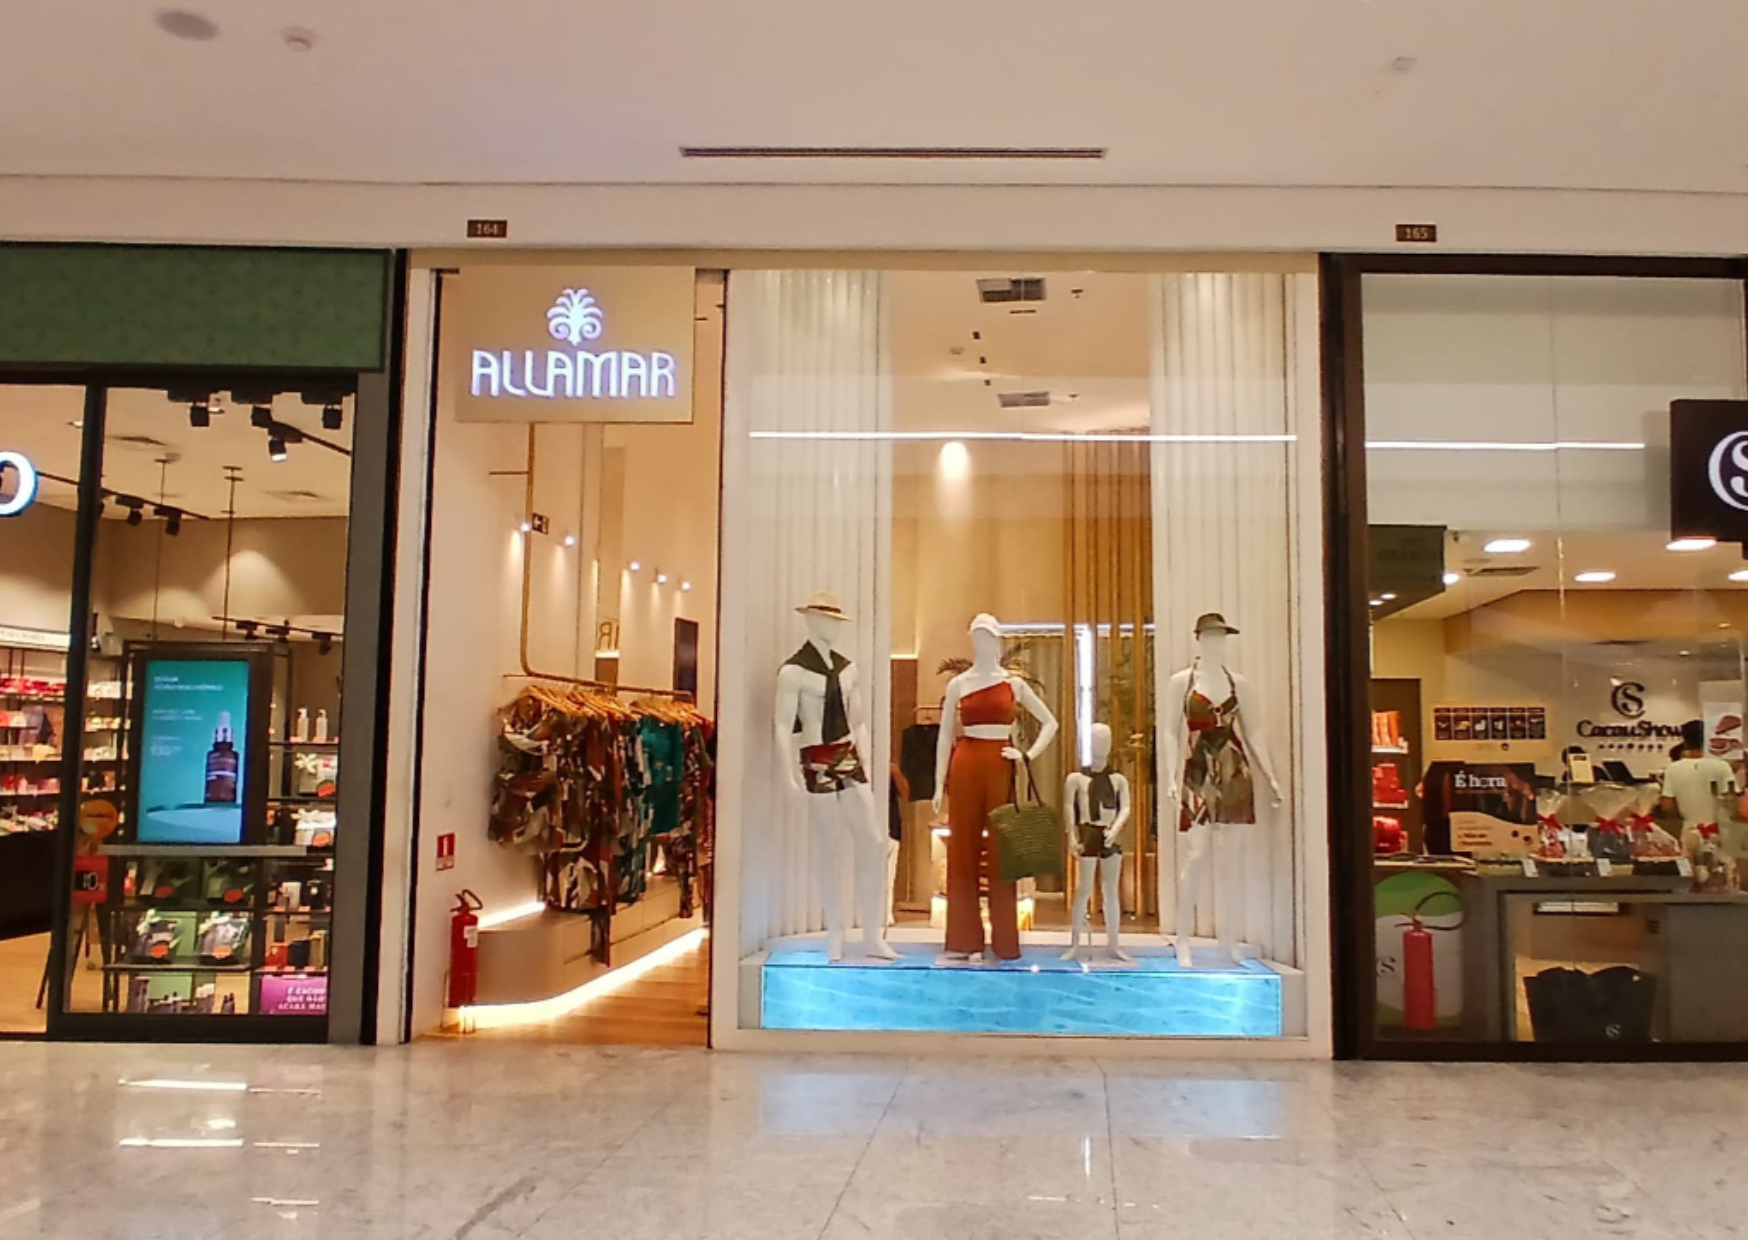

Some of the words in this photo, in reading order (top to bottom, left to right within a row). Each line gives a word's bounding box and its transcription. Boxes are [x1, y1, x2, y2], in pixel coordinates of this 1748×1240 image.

[476, 223, 498, 236] 164
[1405, 227, 1429, 240] 165
[471, 350, 676, 398] ALLAMAR
[1454, 769, 1467, 788] É
